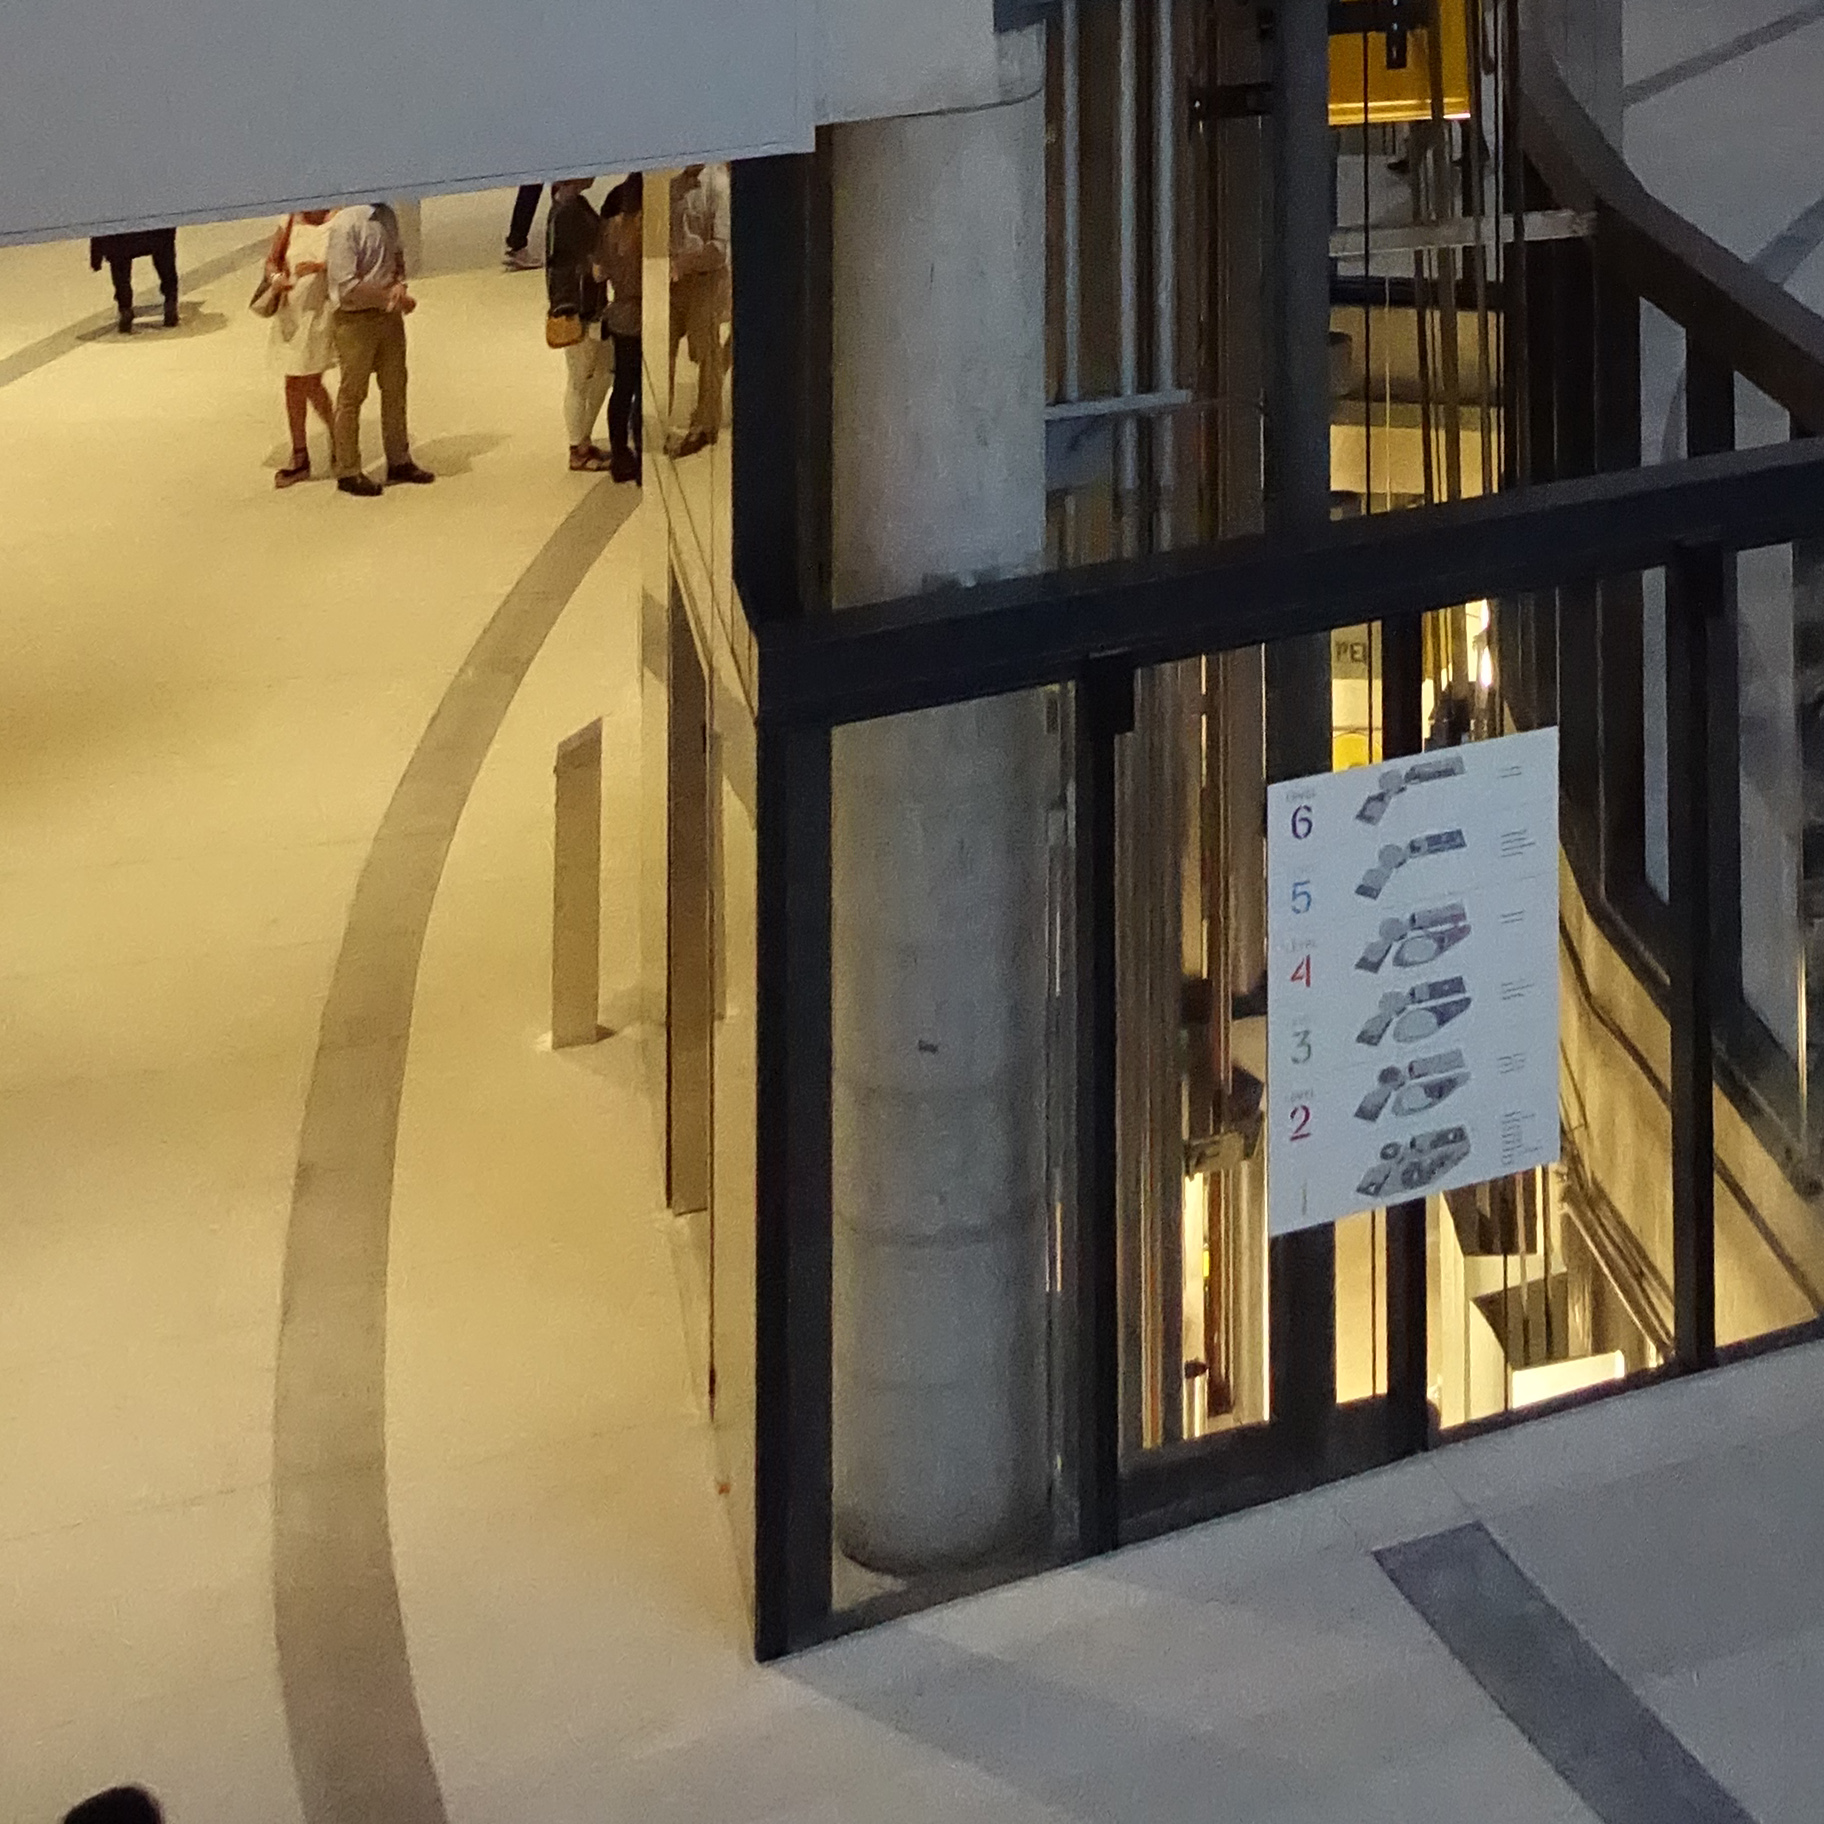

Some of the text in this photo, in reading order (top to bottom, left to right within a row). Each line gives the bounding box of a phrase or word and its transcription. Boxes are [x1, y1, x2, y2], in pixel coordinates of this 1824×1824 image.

[1291, 805, 1313, 839] 6
[1291, 880, 1312, 914] 5
[1290, 954, 1311, 988] 4
[1291, 1030, 1312, 1064] 3
[1290, 1105, 1311, 1141] 2
